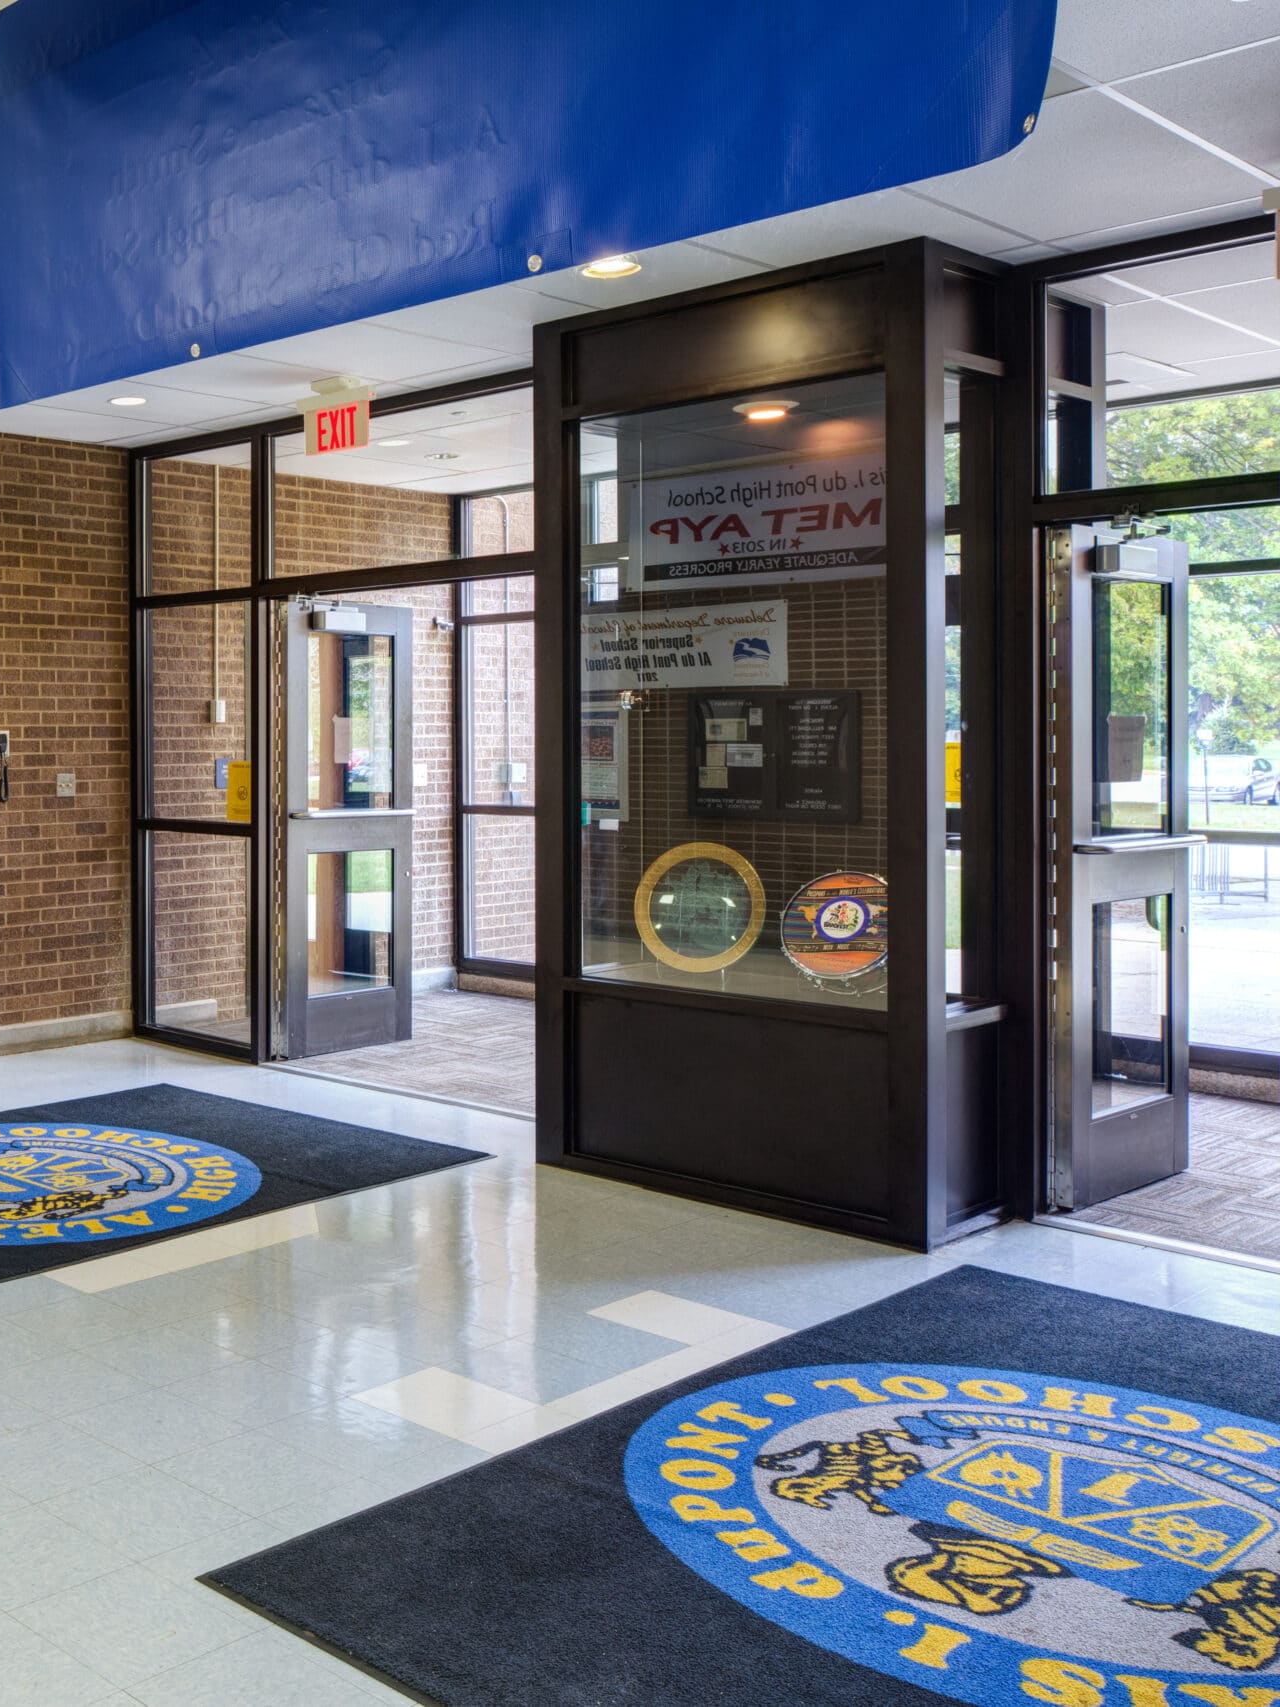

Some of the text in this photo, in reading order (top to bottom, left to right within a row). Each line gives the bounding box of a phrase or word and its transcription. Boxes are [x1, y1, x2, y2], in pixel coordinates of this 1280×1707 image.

[317, 406, 357, 452] EXIT
[177, 1155, 238, 1202] HIGH
[814, 1374, 1280, 1454] SCHOOL
[939, 1413, 1279, 1494] UPRIGHT & ENDURE
[659, 1401, 845, 1599] duPONT
[883, 1609, 970, 1669] I.
